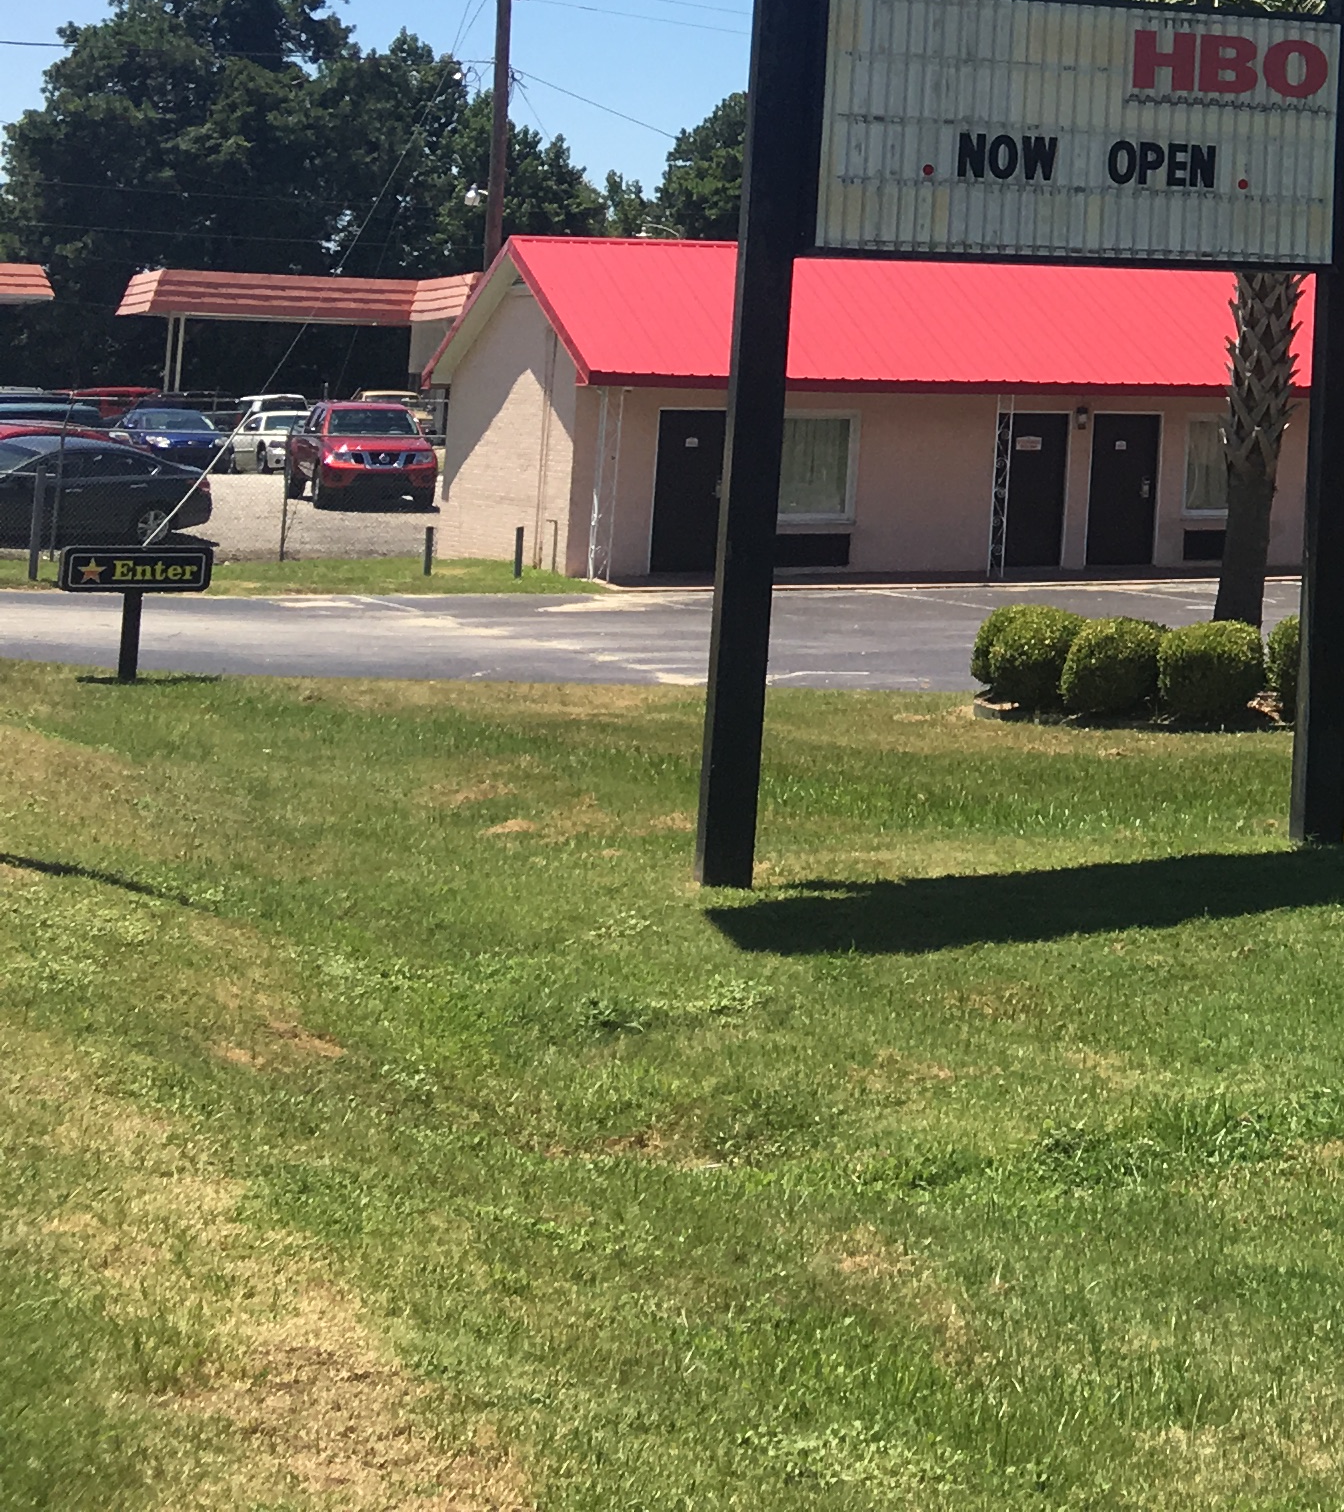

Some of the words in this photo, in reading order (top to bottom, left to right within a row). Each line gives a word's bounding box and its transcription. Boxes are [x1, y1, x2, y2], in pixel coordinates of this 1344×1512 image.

[1132, 29, 1329, 99] HBO
[956, 131, 1059, 181] NOW
[1107, 139, 1217, 189] OPEN
[111, 560, 198, 581] Enter
